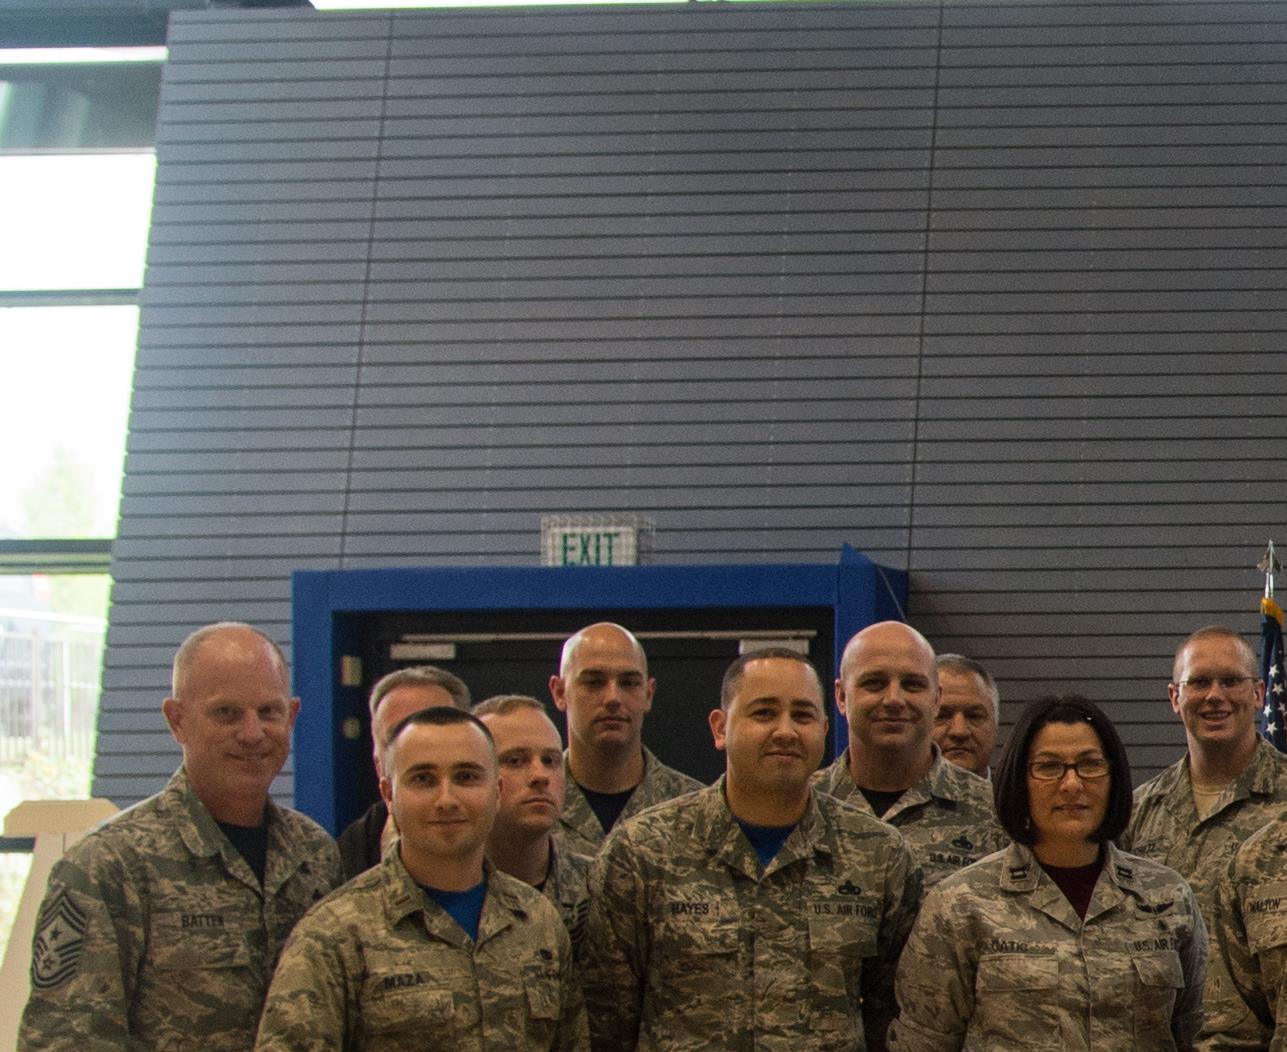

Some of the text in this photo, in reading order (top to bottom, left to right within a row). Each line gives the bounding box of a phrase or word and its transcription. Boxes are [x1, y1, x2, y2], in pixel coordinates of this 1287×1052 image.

[562, 532, 620, 566] EXIT
[814, 904, 831, 916] U.S.
[837, 904, 853, 916] AIR
